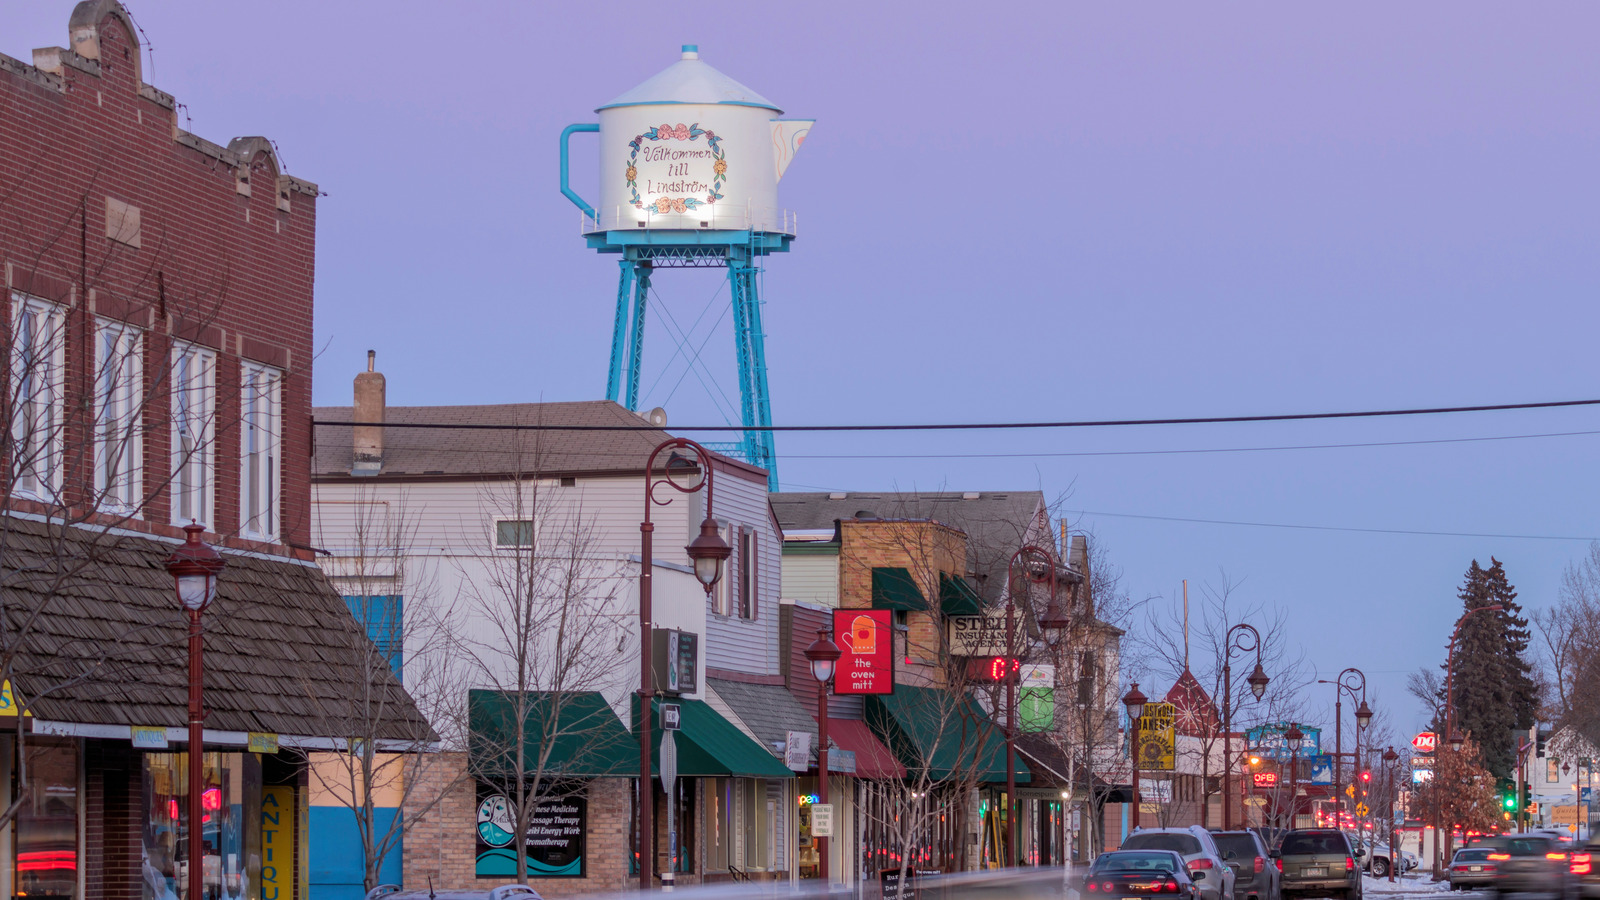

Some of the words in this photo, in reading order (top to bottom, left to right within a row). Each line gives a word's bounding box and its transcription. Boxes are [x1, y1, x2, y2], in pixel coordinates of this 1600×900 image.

[643, 145, 711, 162] Välkommen
[668, 163, 689, 176] till
[647, 179, 708, 194] Lindström
[855, 658, 871, 668] the
[852, 681, 873, 689] mitt
[135, 730, 164, 744] ANTIQUES
[1416, 737, 1435, 747] DQ
[1249, 739, 1317, 748] LIQUR
[797, 794, 820, 806] pen
[551, 805, 578, 813] Medicine
[528, 816, 553, 825] assage
[554, 816, 580, 825] Therapy
[540, 827, 563, 836] Energy
[563, 827, 580, 835] Work
[885, 882, 910, 892] Desn
[883, 891, 915, 900] Boutque
